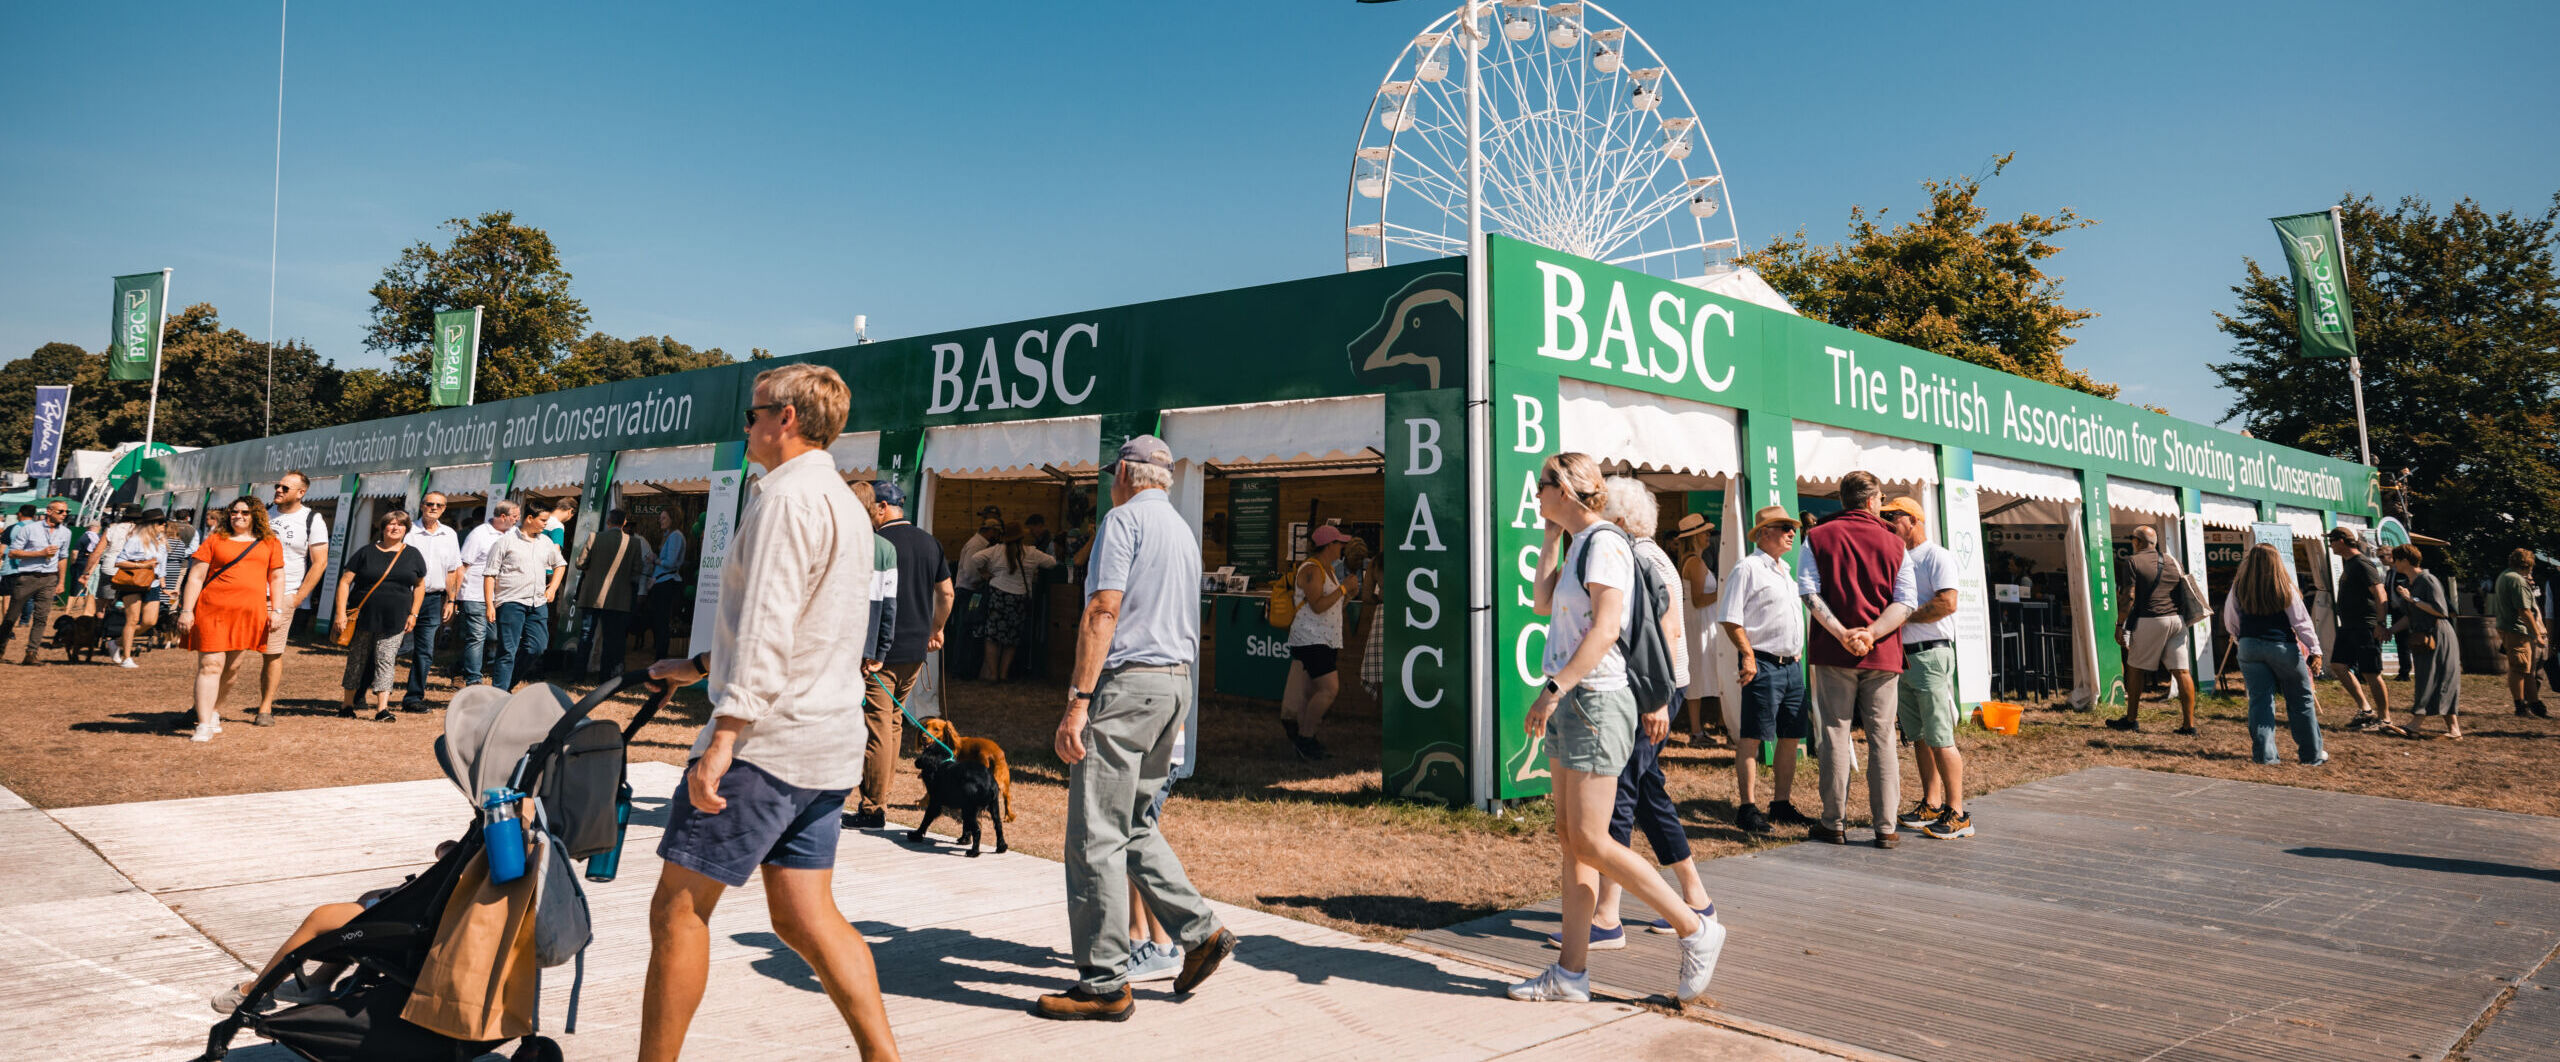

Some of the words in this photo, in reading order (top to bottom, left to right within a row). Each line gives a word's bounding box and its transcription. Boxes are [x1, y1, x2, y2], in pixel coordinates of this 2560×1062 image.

[926, 322, 1099, 415] BASC
[1536, 260, 1735, 393] BASC
[264, 445, 282, 472] The
[284, 437, 319, 469] British
[324, 429, 396, 466] Association
[400, 424, 423, 458] for
[423, 415, 497, 461] Shooting
[503, 404, 540, 449] and
[542, 388, 693, 444] Conservation
[1825, 345, 1888, 415] The
[1900, 365, 1990, 435] British
[2003, 390, 2128, 462] Association
[2131, 421, 2157, 467] for
[2163, 428, 2236, 492] Shooting
[2239, 450, 2265, 488] and
[2267, 454, 2344, 501] Conservation
[635, 505, 662, 514] BASC
[1511, 394, 1551, 688] BASC
[2094, 486, 2109, 611] FIREARMS
[2208, 547, 2245, 562] offe
[1399, 417, 1447, 709] BASC
[1246, 634, 1291, 659] Sales
[341, 930, 364, 941] YOYO
